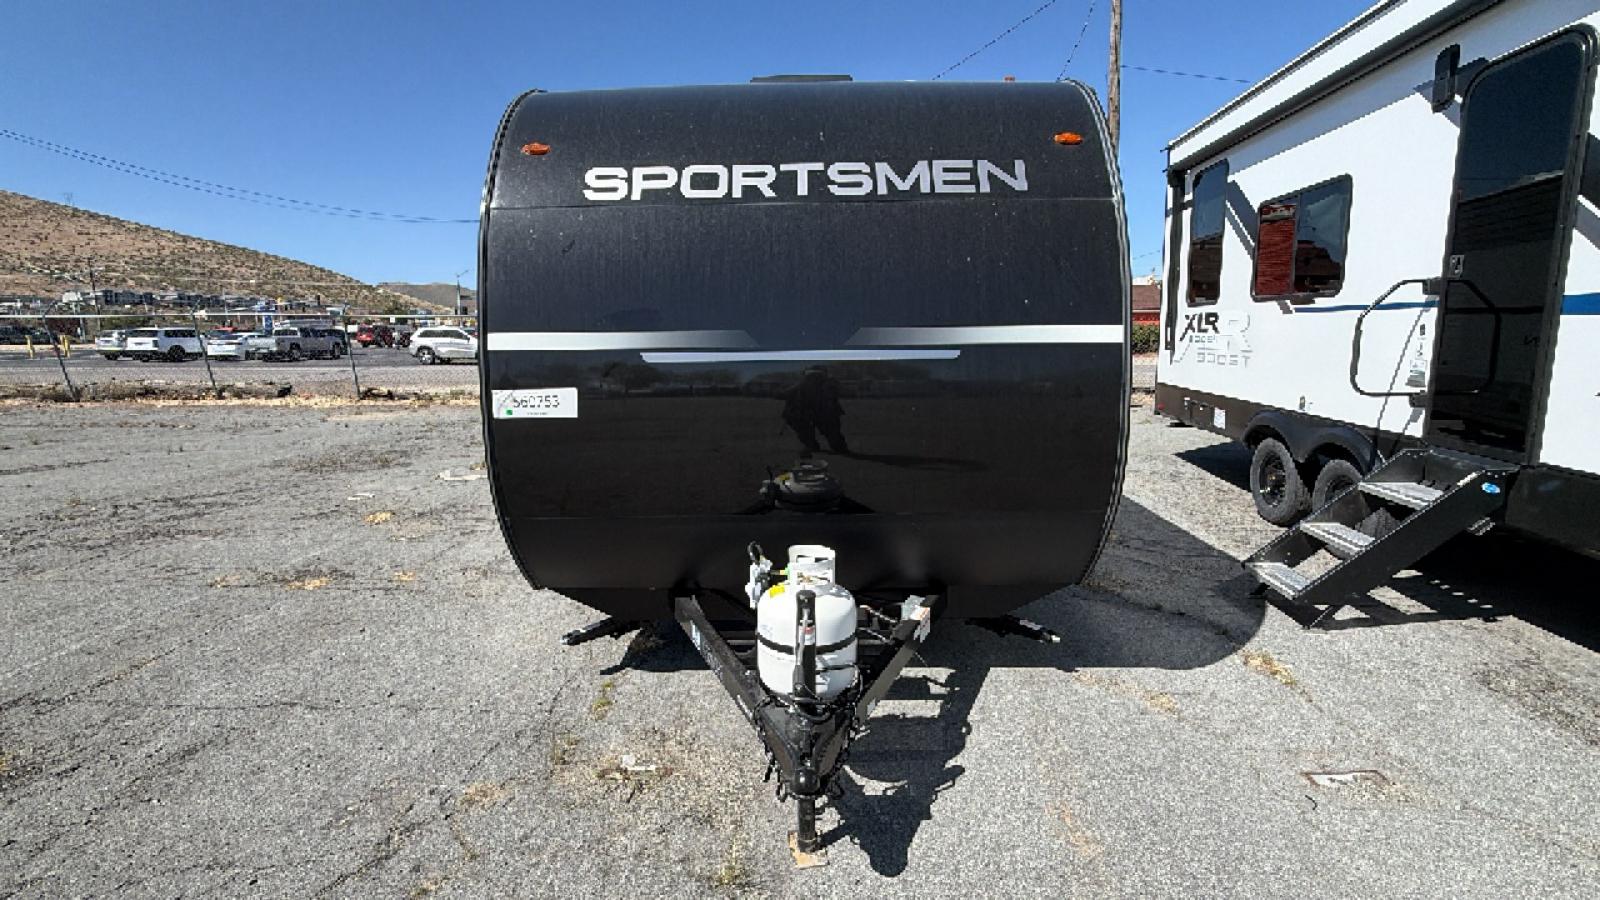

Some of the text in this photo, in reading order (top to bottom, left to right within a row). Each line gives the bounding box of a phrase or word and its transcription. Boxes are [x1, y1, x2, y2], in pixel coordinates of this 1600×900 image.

[582, 159, 1028, 201] SPORTSMEN
[1179, 312, 1220, 342] XLR
[513, 394, 560, 408] 560753
